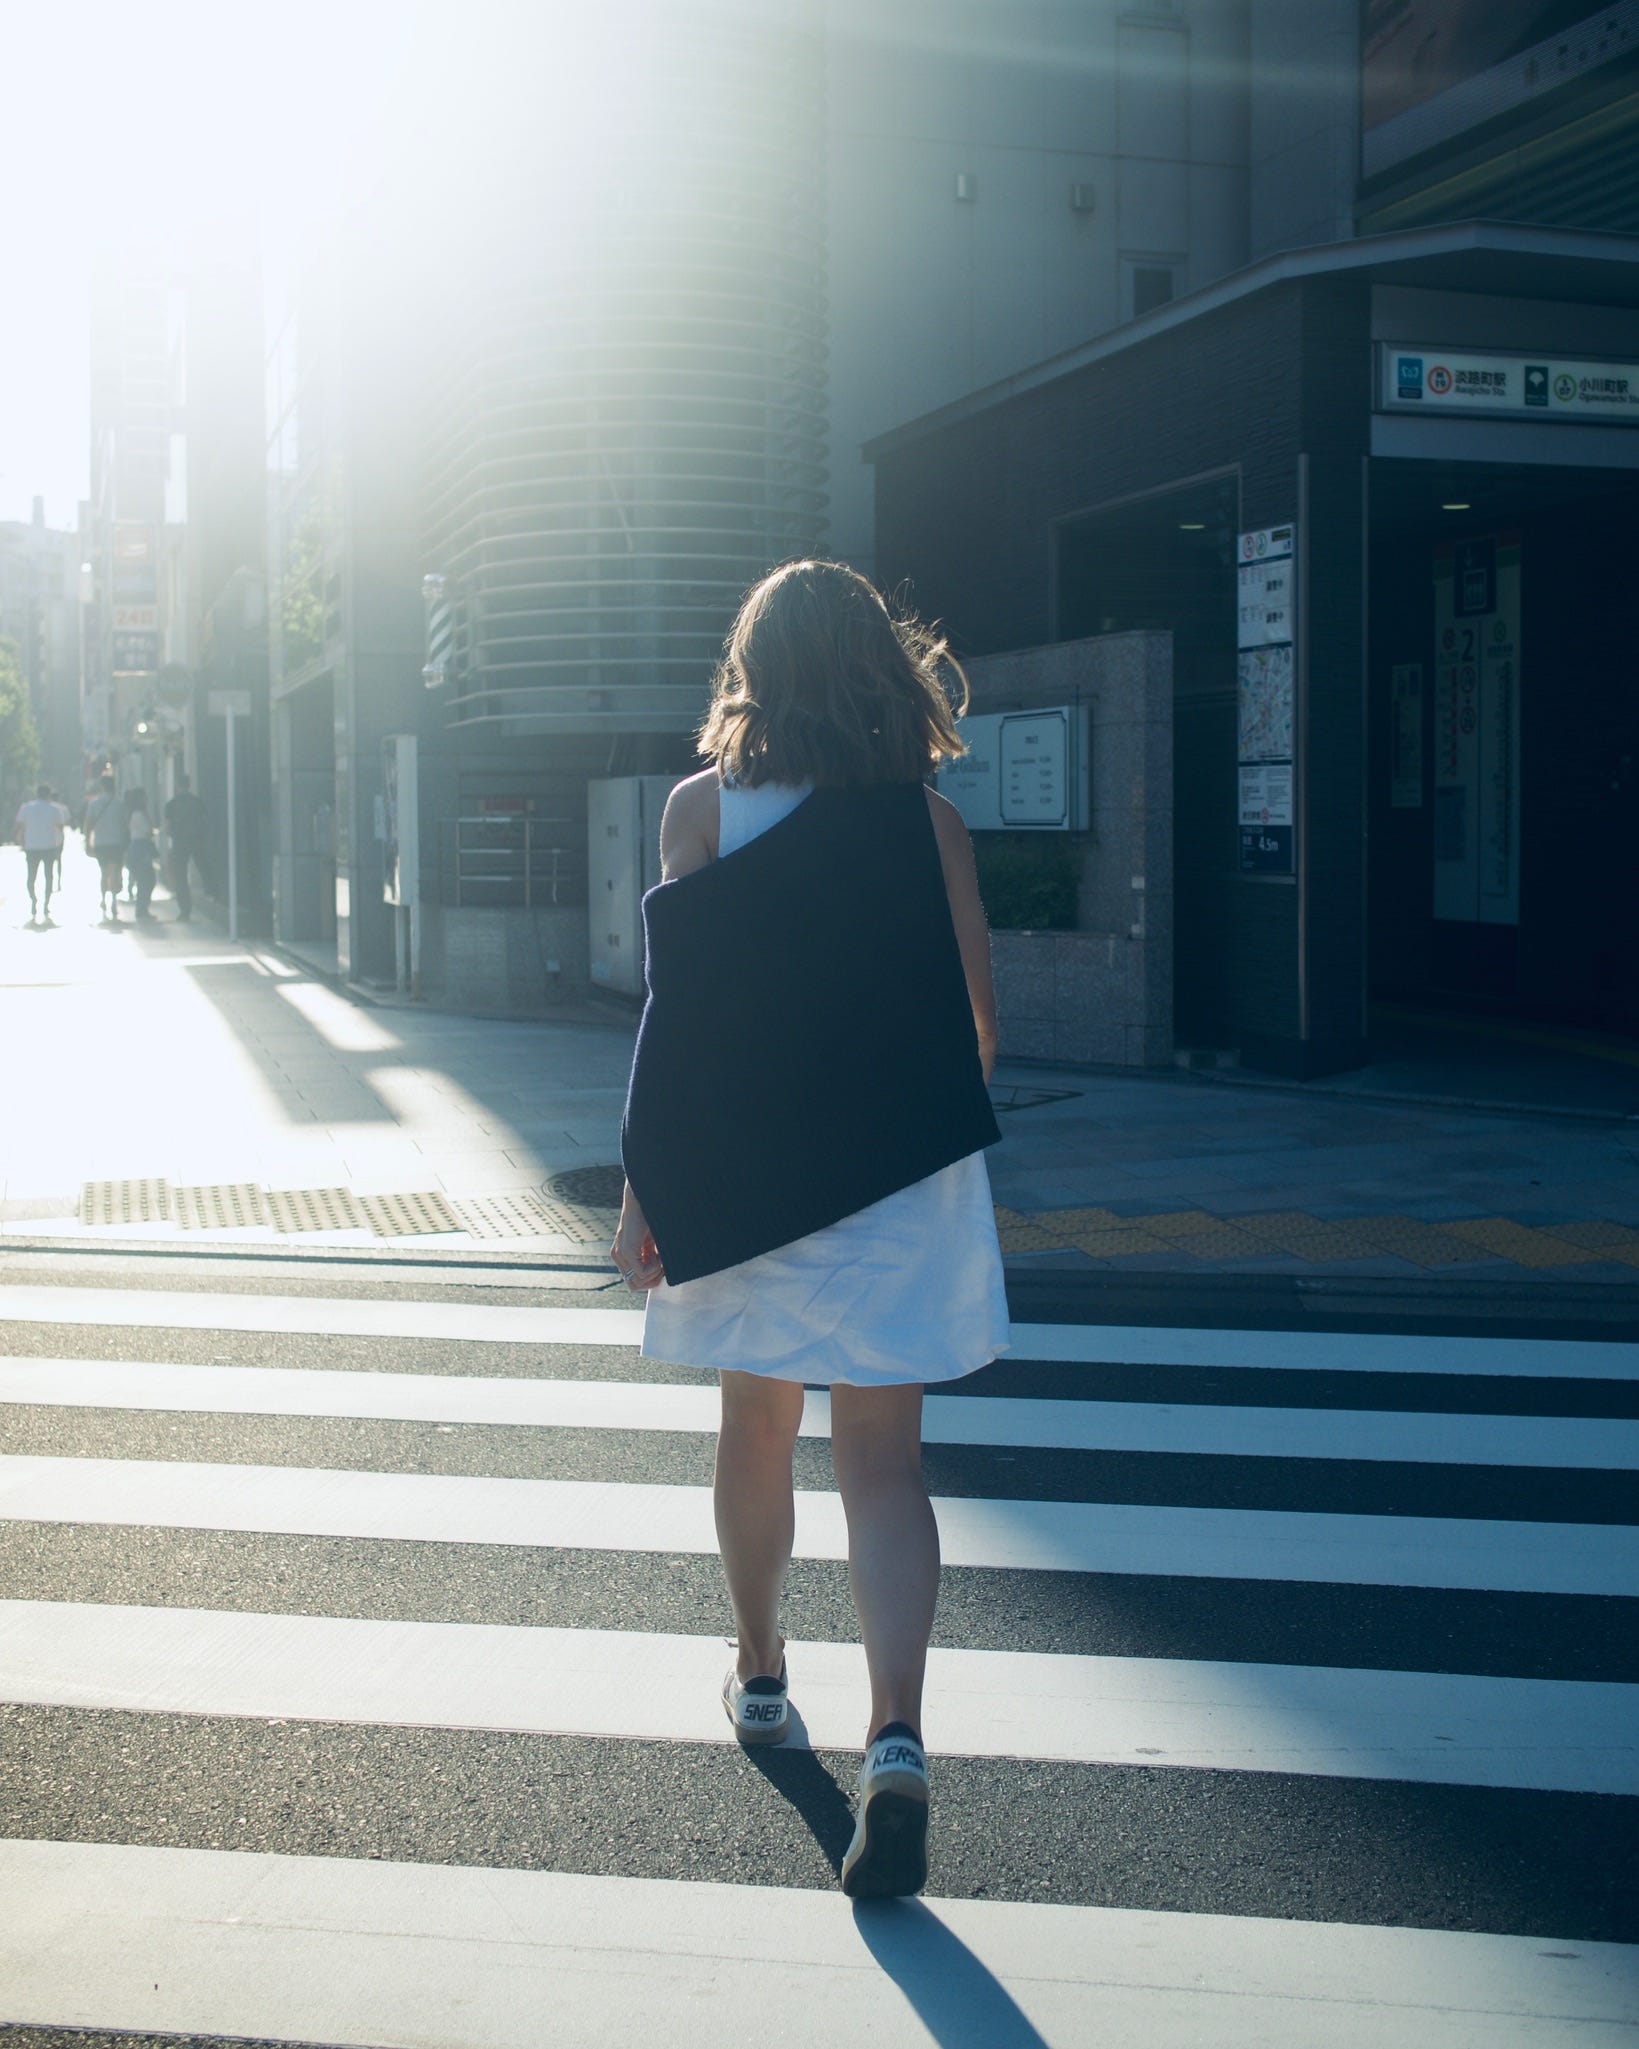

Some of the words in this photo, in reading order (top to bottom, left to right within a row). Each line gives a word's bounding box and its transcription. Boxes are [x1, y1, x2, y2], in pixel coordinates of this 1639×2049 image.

[1455, 369, 1506, 387] 淡路町駅
[1579, 377, 1629, 393] 小川町駅
[1461, 628, 1474, 661] 2
[744, 1704, 782, 1721] SNEA
